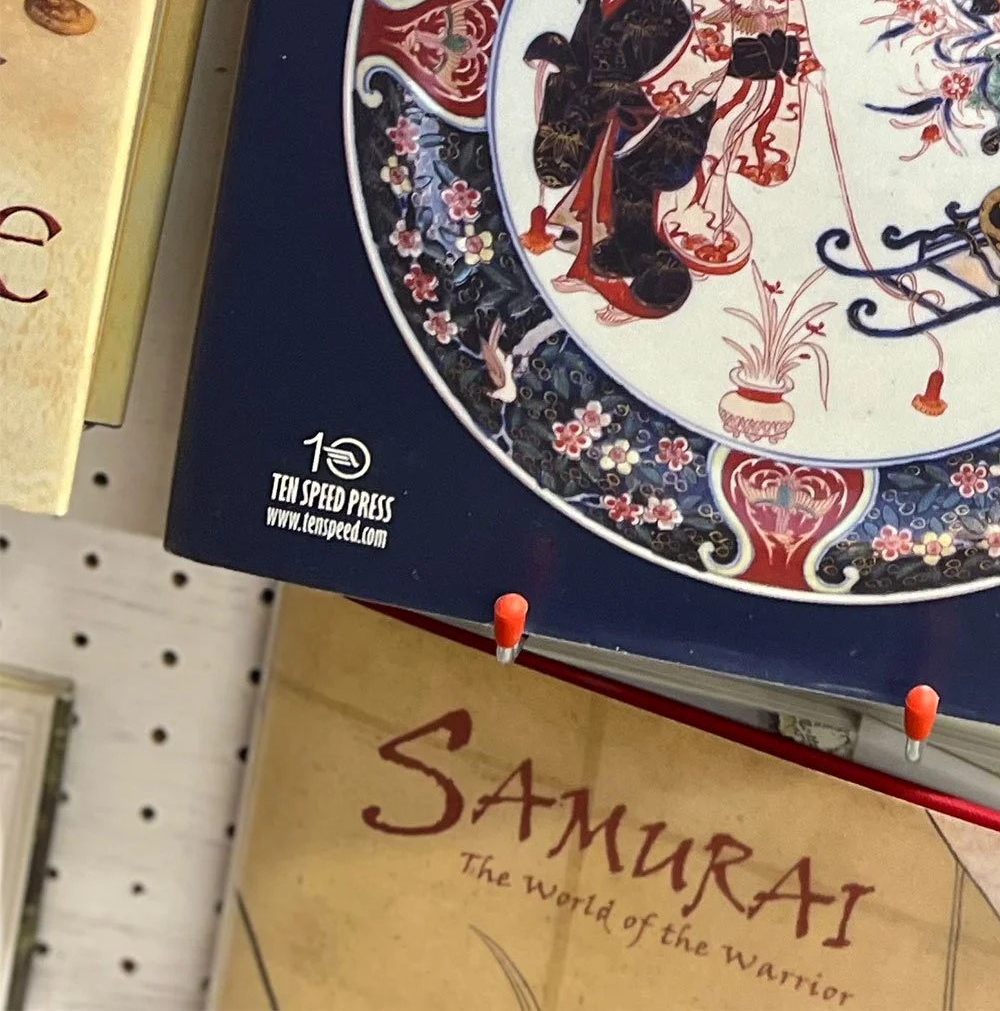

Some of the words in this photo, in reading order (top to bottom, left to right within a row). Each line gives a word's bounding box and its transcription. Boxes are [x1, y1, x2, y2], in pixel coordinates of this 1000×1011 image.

[266, 506, 388, 549] www.tenspeed.com
[271, 472, 300, 504] TEN
[300, 479, 346, 513] SPEED
[346, 488, 395, 523] PRESS
[361, 708, 876, 949] SAMURAI
[459, 850, 512, 888] The
[622, 912, 660, 949] of
[660, 920, 710, 958] the
